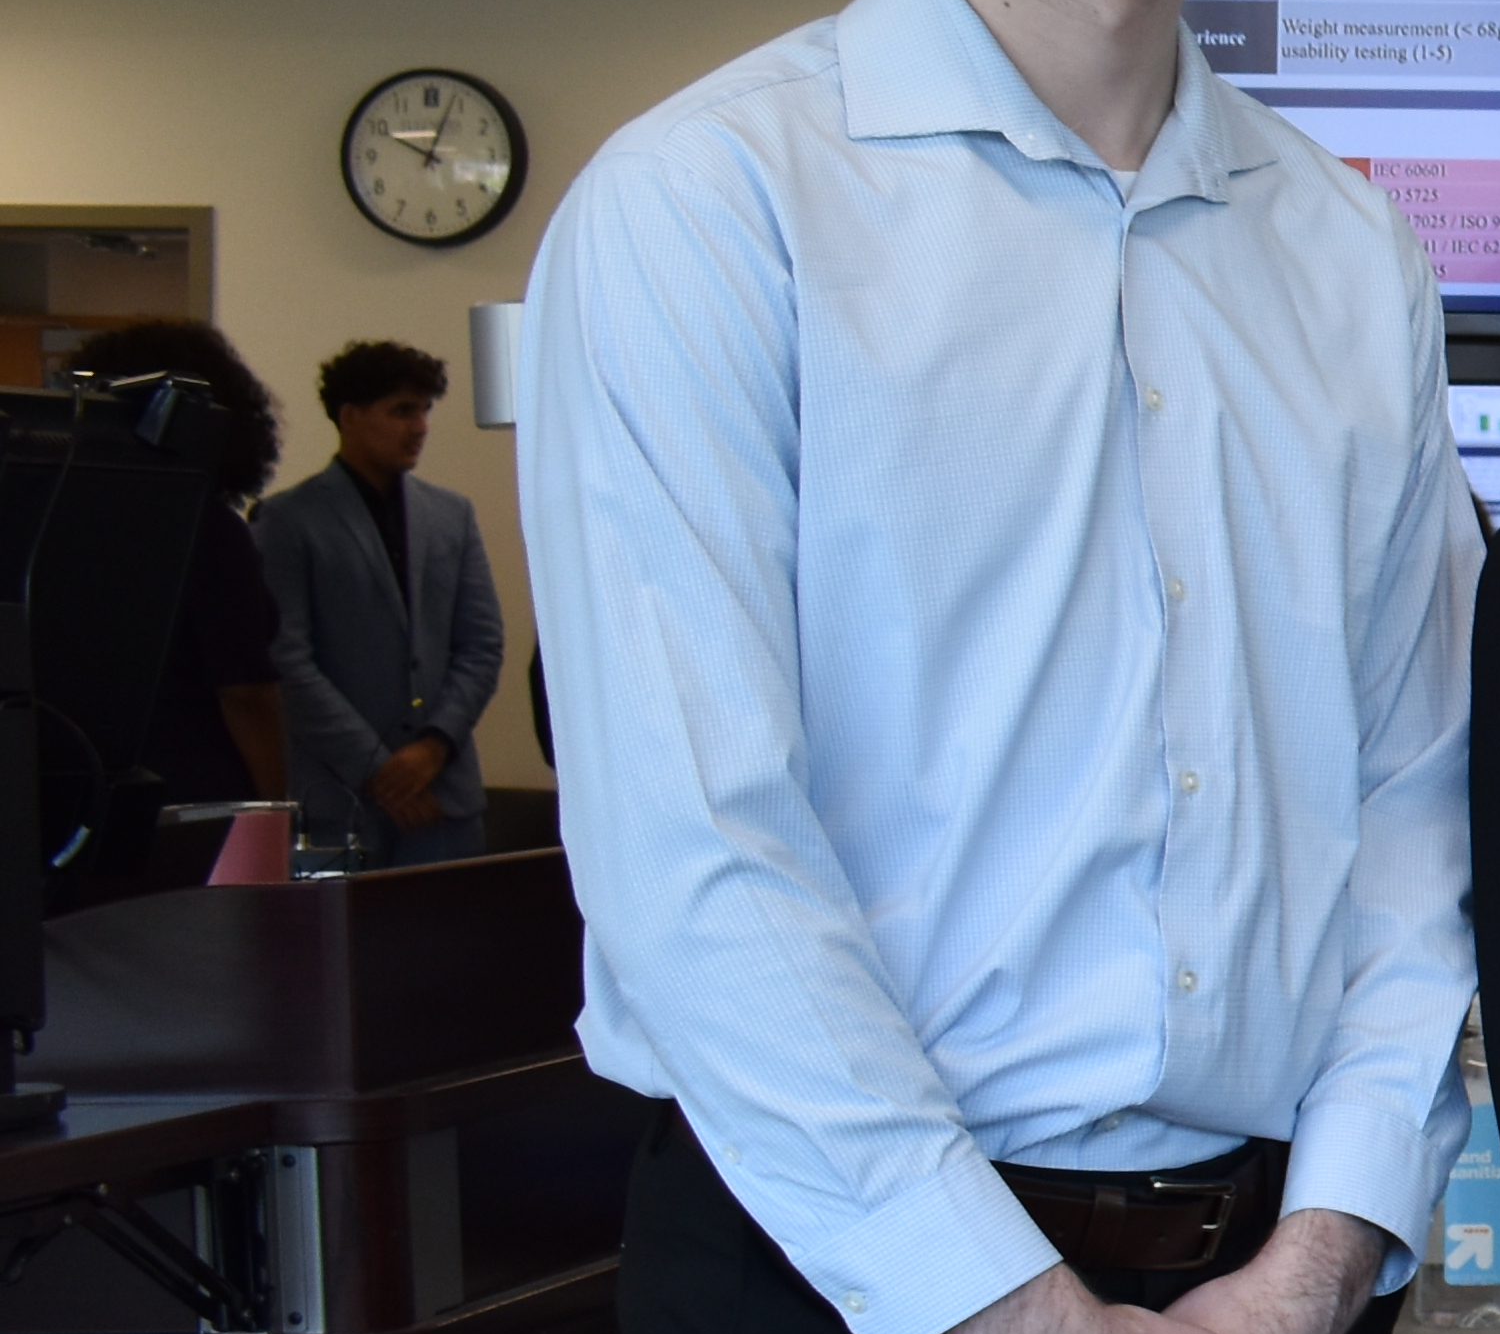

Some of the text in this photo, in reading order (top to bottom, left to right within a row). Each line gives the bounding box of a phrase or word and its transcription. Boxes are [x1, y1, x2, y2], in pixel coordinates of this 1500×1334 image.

[1281, 17, 1338, 39] Weight
[1343, 23, 1448, 37] measurement
[1453, 21, 1472, 39] (<
